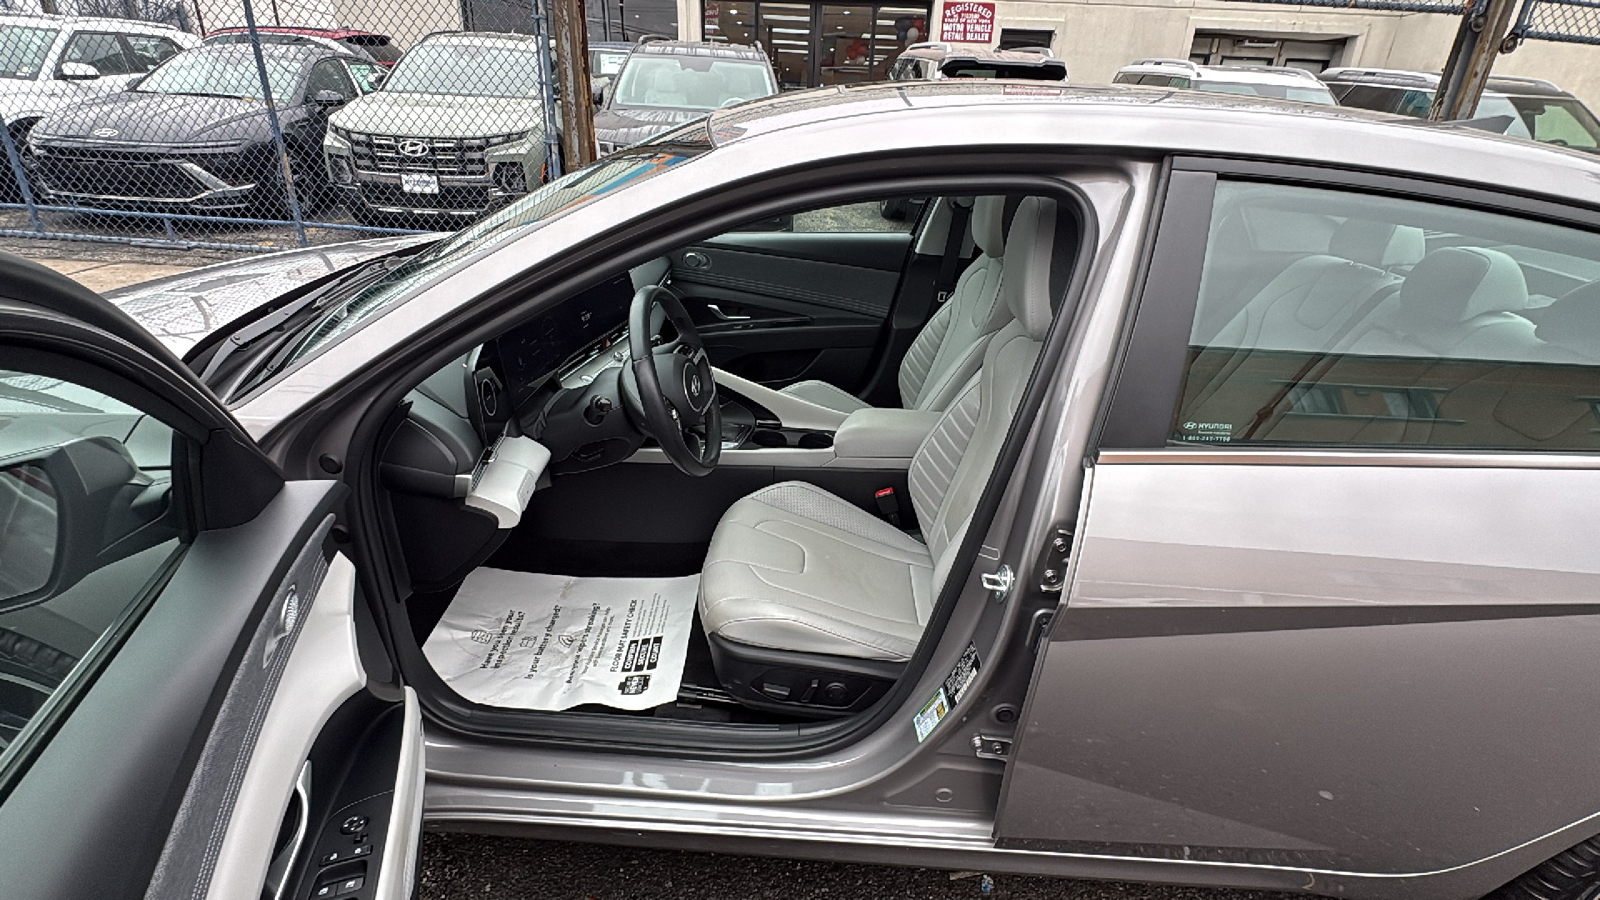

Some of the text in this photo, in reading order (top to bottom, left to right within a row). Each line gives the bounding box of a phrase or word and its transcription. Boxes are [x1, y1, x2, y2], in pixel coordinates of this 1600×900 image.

[945, 3, 992, 19] REGISTERED
[942, 32, 990, 40] RETAIL DEALER
[943, 22, 992, 32] MOTOR VEHICLE
[584, 602, 600, 633] streaking?
[530, 656, 541, 673] your
[536, 632, 552, 656] battery
[546, 604, 562, 632] charged?
[610, 600, 638, 672] FLOOR MAT SAFETY CHECK
[480, 652, 492, 669] Have
[624, 642, 638, 669] CONFIRM
[637, 643, 648, 666] SECURE
